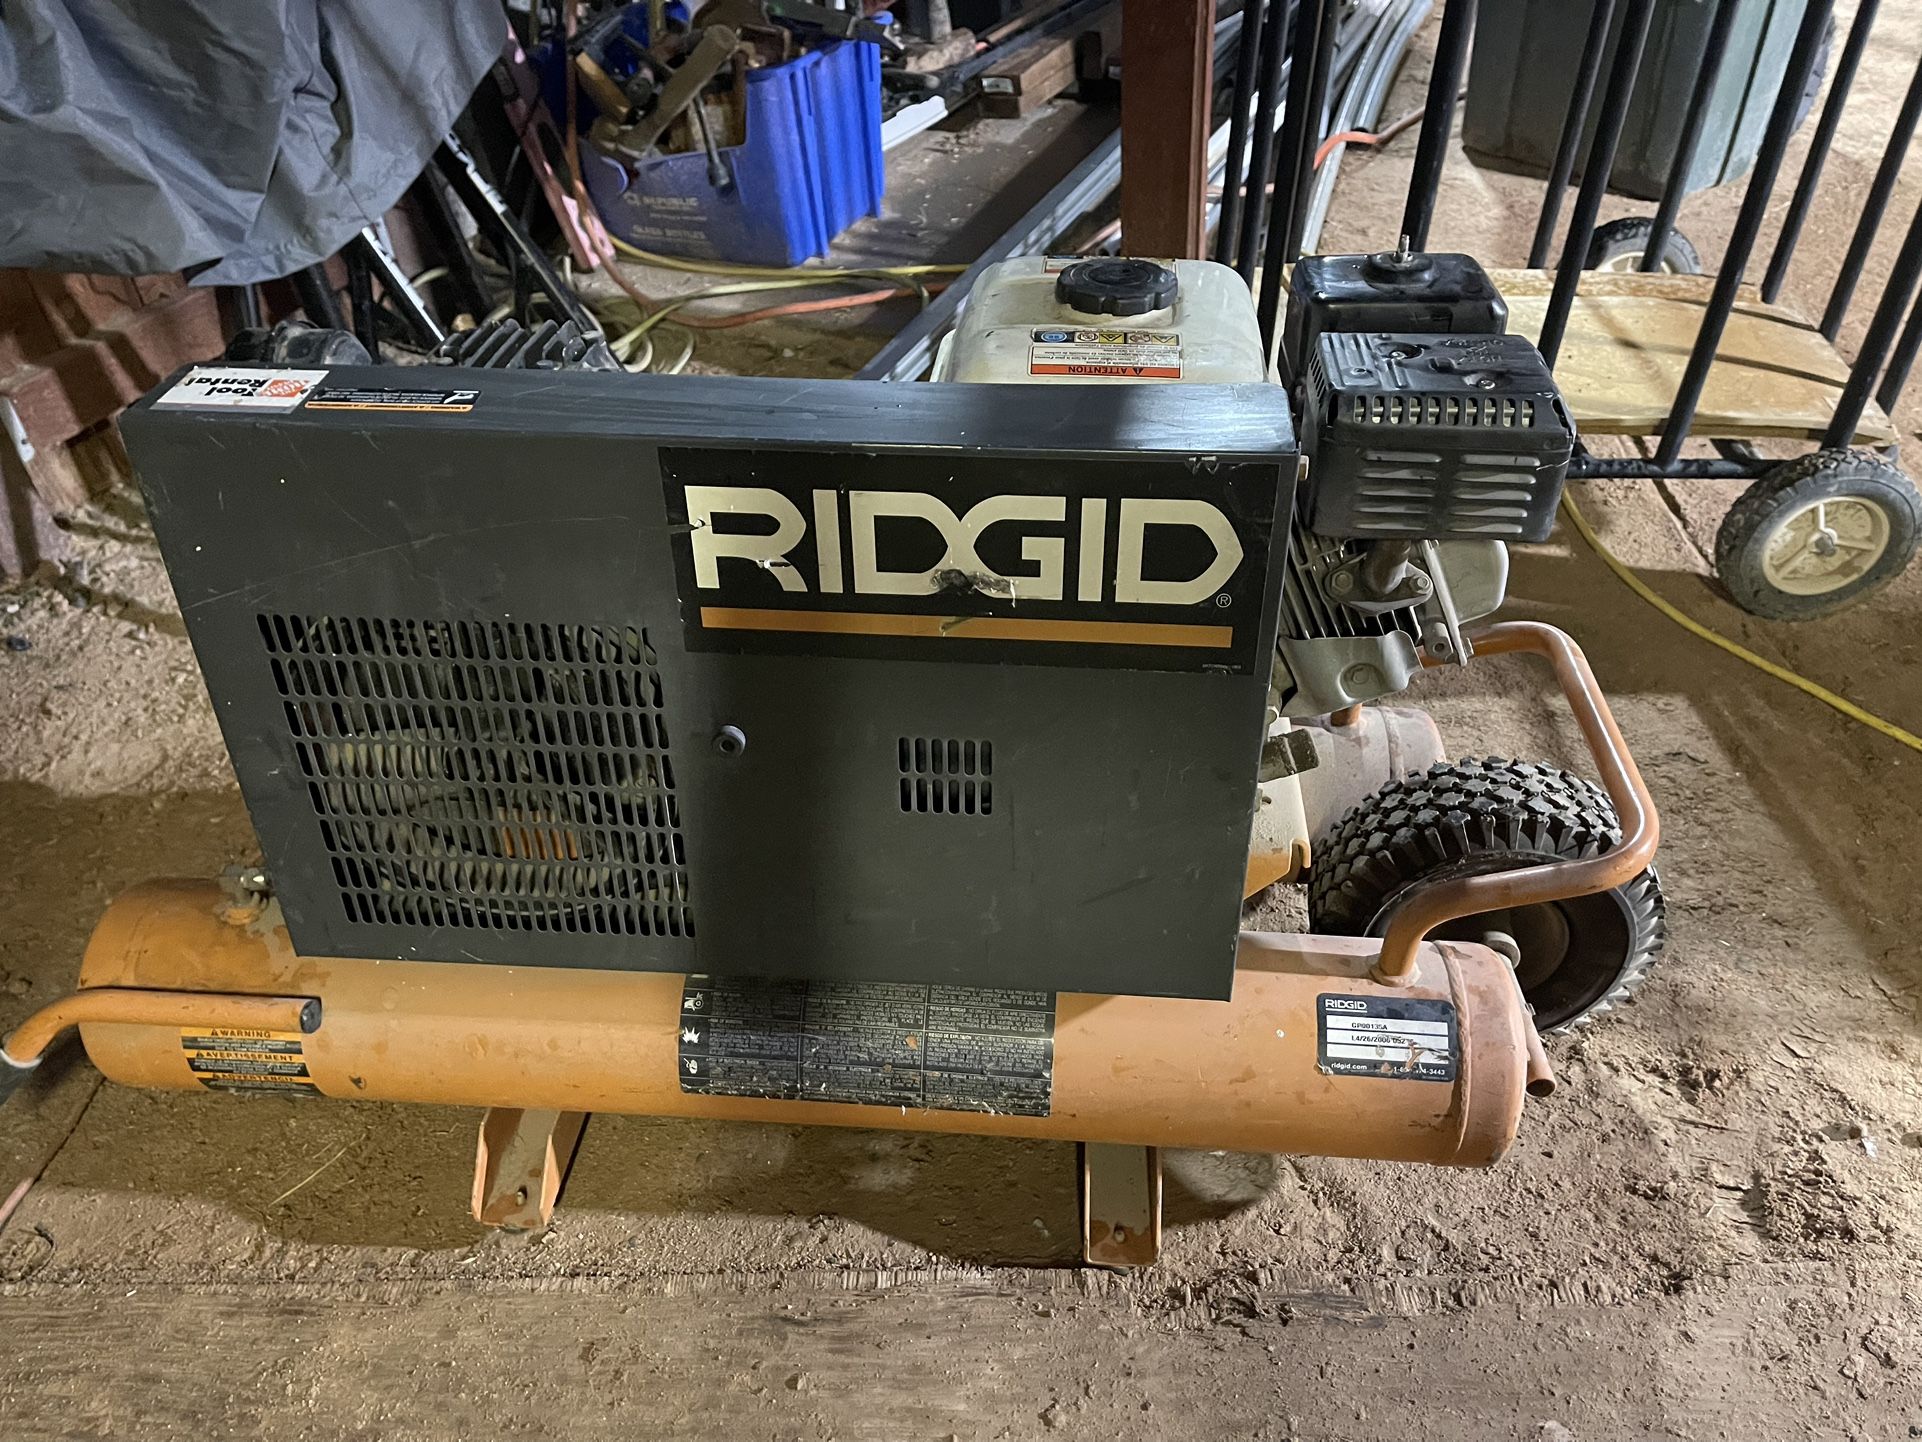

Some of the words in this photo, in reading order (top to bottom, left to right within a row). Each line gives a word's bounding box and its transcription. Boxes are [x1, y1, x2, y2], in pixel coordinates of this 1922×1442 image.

[1068, 366, 1127, 374] ATTENTION
[184, 378, 271, 387] Rental
[204, 387, 257, 396] Tool
[684, 485, 1244, 605] RIDGID
[1325, 999, 1367, 1009] RIDGID
[220, 1029, 271, 1038] WARNING
[206, 1051, 293, 1061] AVERTISSEMENT
[1331, 1062, 1367, 1071] ridgid.com
